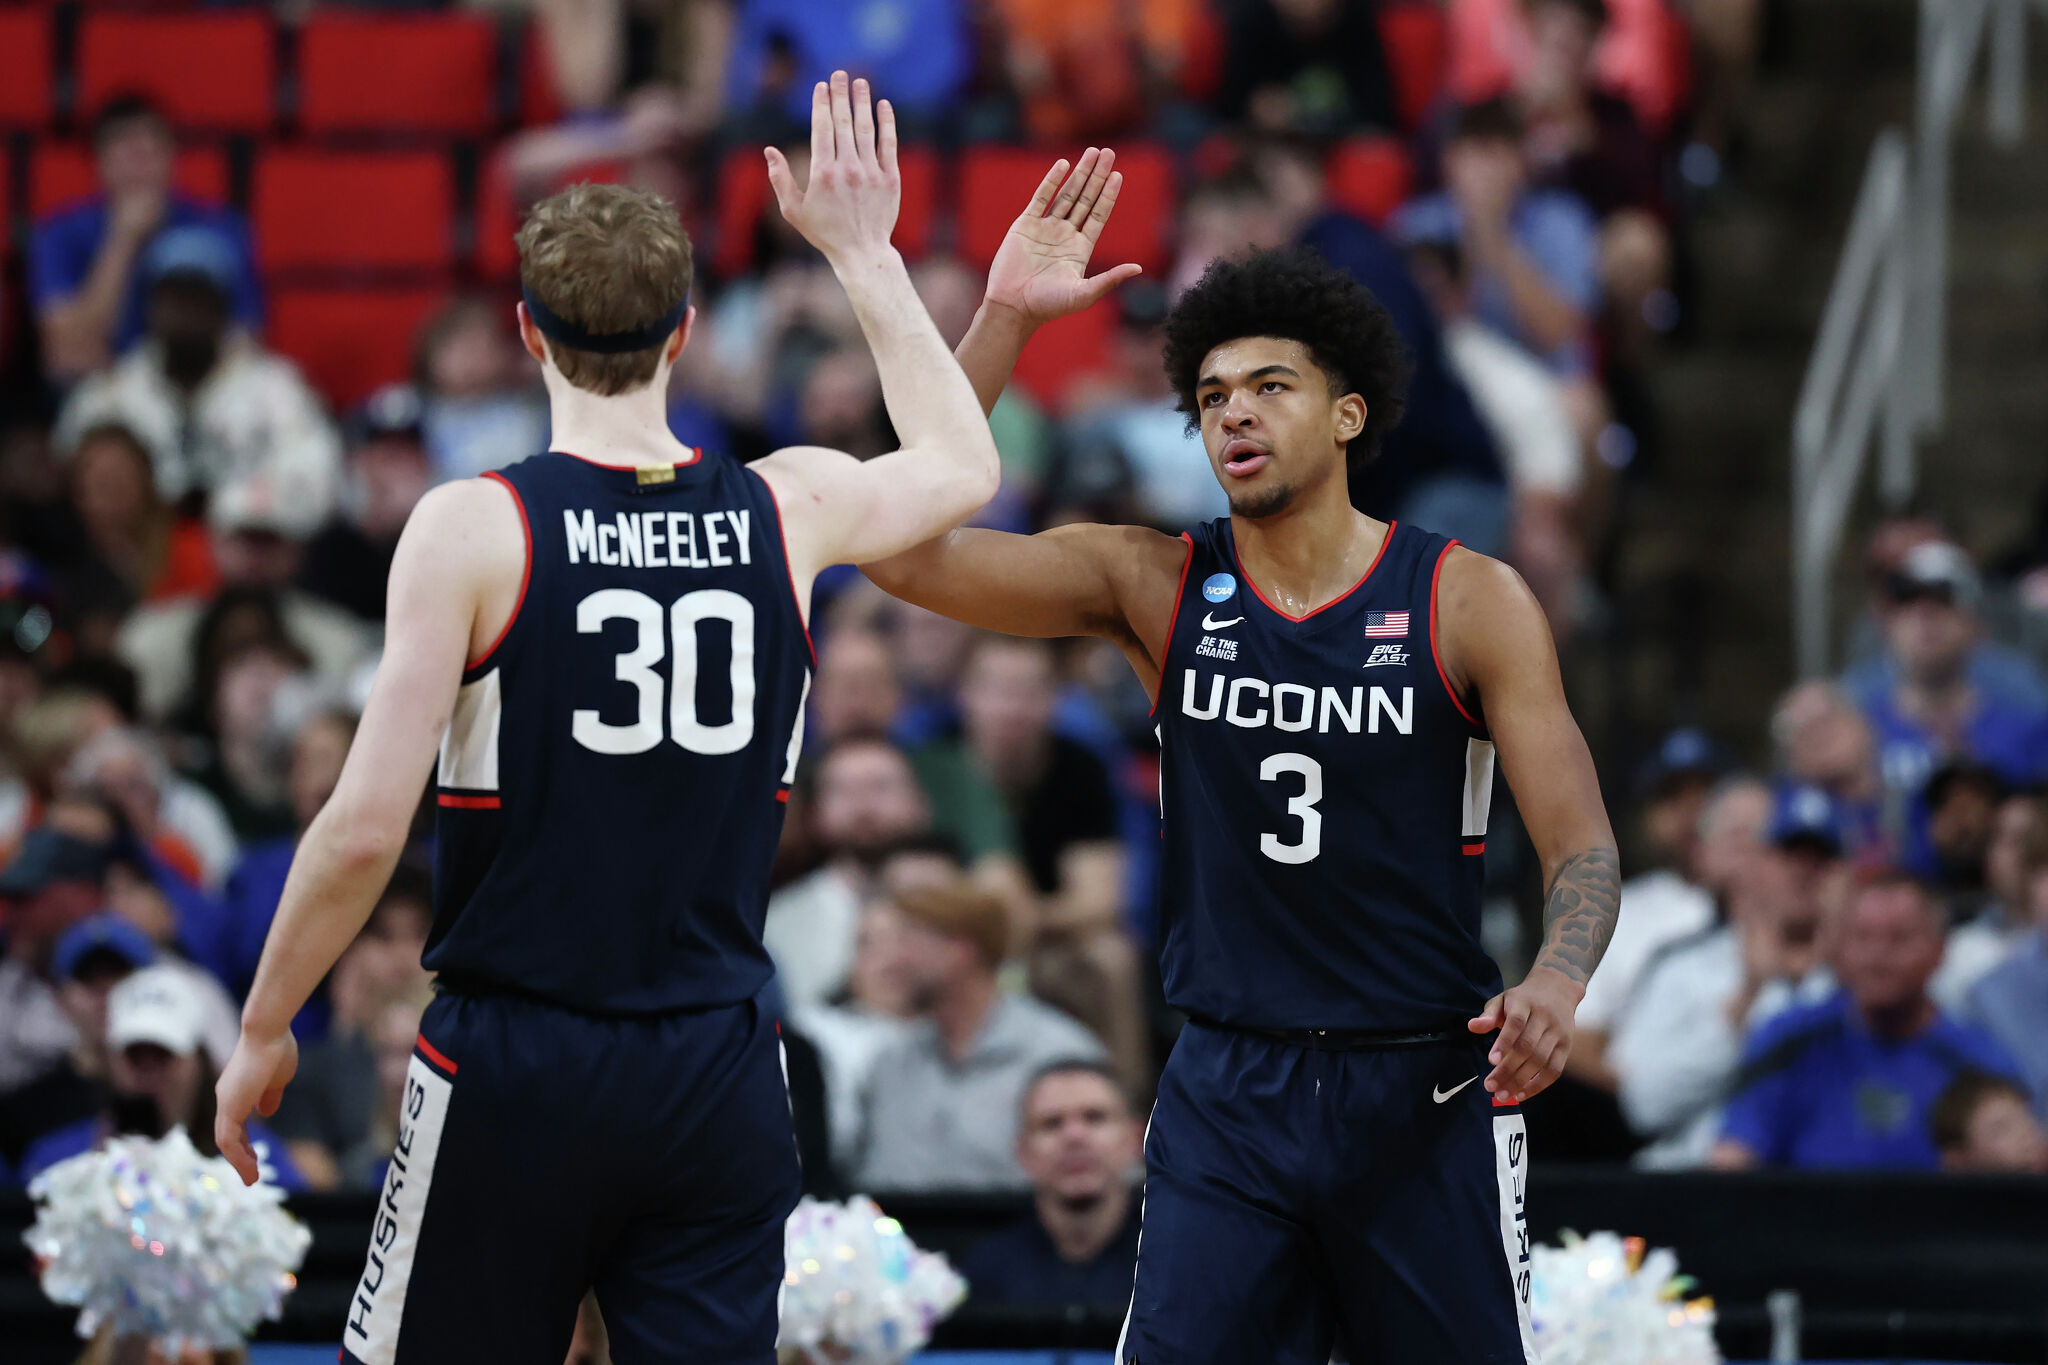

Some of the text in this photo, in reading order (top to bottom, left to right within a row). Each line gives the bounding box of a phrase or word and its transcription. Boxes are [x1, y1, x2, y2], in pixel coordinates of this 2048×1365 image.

[563, 509, 752, 569] McNEELEY
[1206, 586, 1232, 596] NCAA
[1196, 645, 1238, 661] CHANGE
[1202, 636, 1238, 651] BE THE
[1366, 653, 1411, 663] EAST
[1371, 644, 1403, 654] BIG
[571, 588, 756, 756] 30
[1182, 669, 1414, 735] UCONN
[1260, 752, 1323, 865] 3
[350, 1077, 425, 1340] HUSKIES
